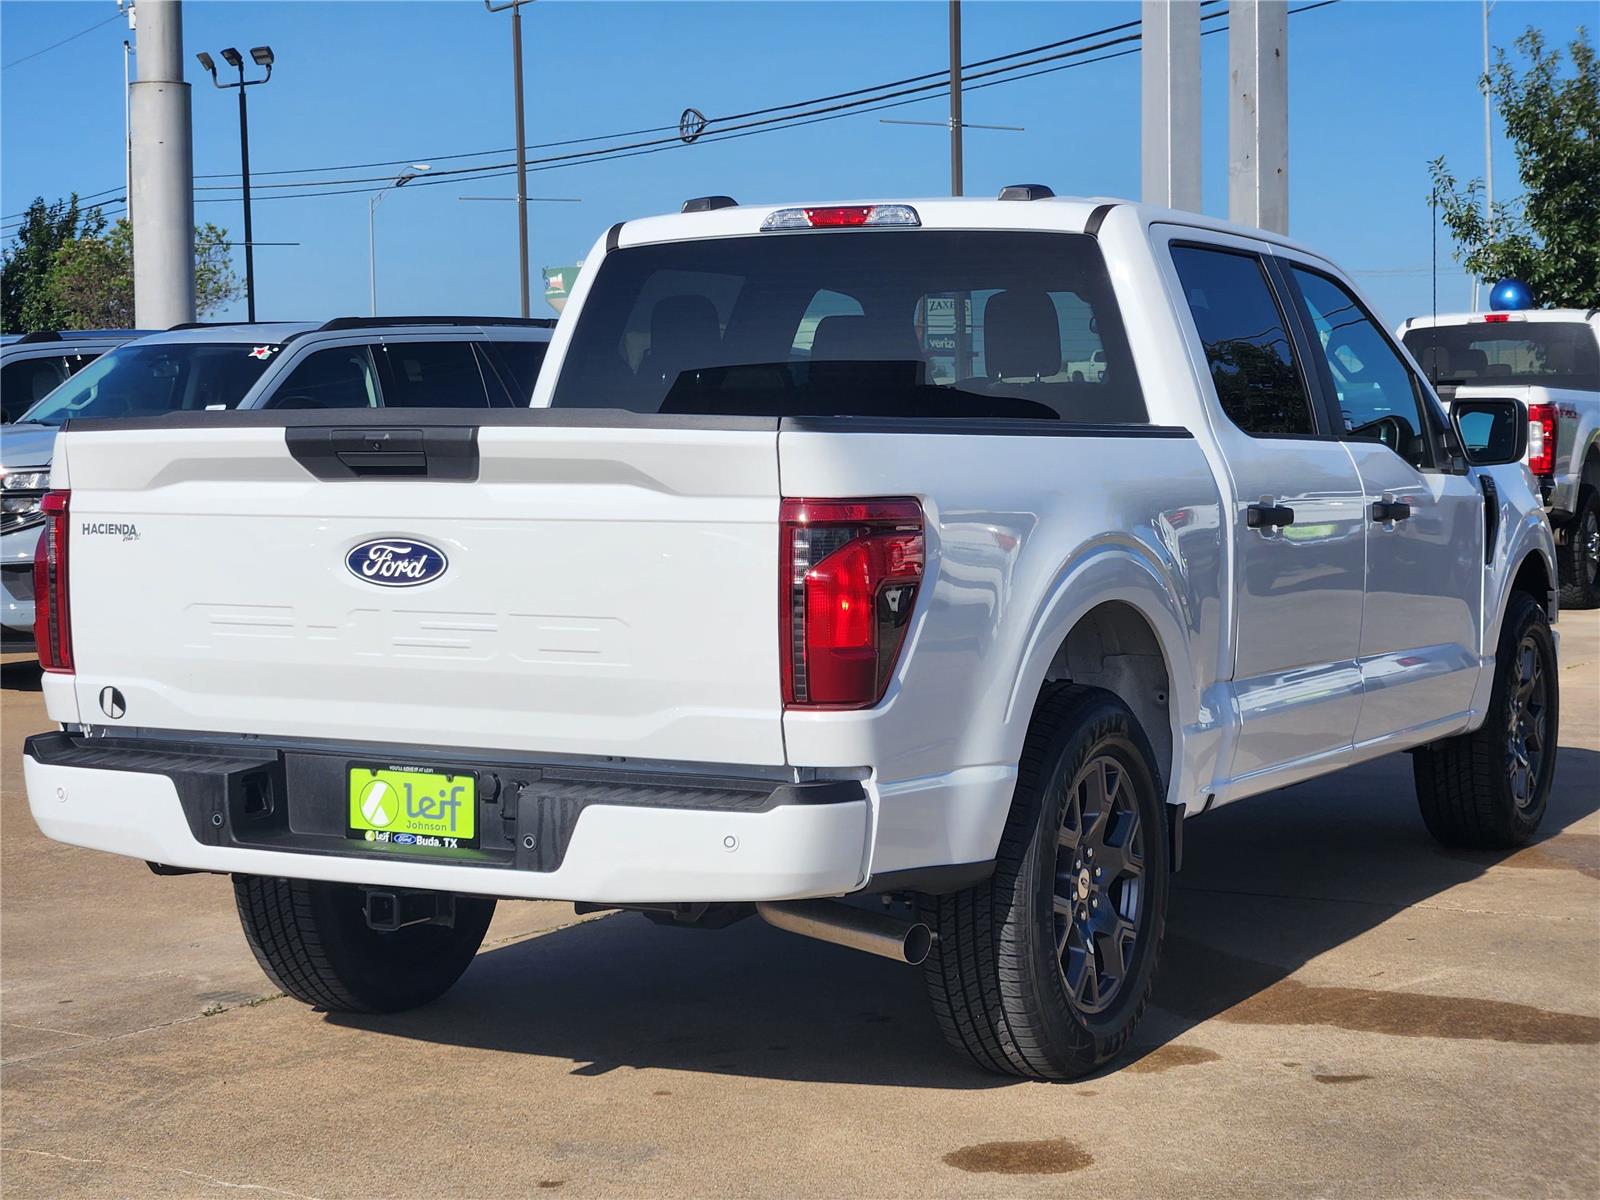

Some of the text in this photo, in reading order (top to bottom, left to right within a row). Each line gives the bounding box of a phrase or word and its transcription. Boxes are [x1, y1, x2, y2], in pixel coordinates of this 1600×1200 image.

[82, 523, 137, 536] HACIENDA
[362, 544, 428, 578] Ford
[406, 820, 447, 831] Johnson
[416, 835, 441, 847] Buda,
[443, 837, 458, 848] TX
